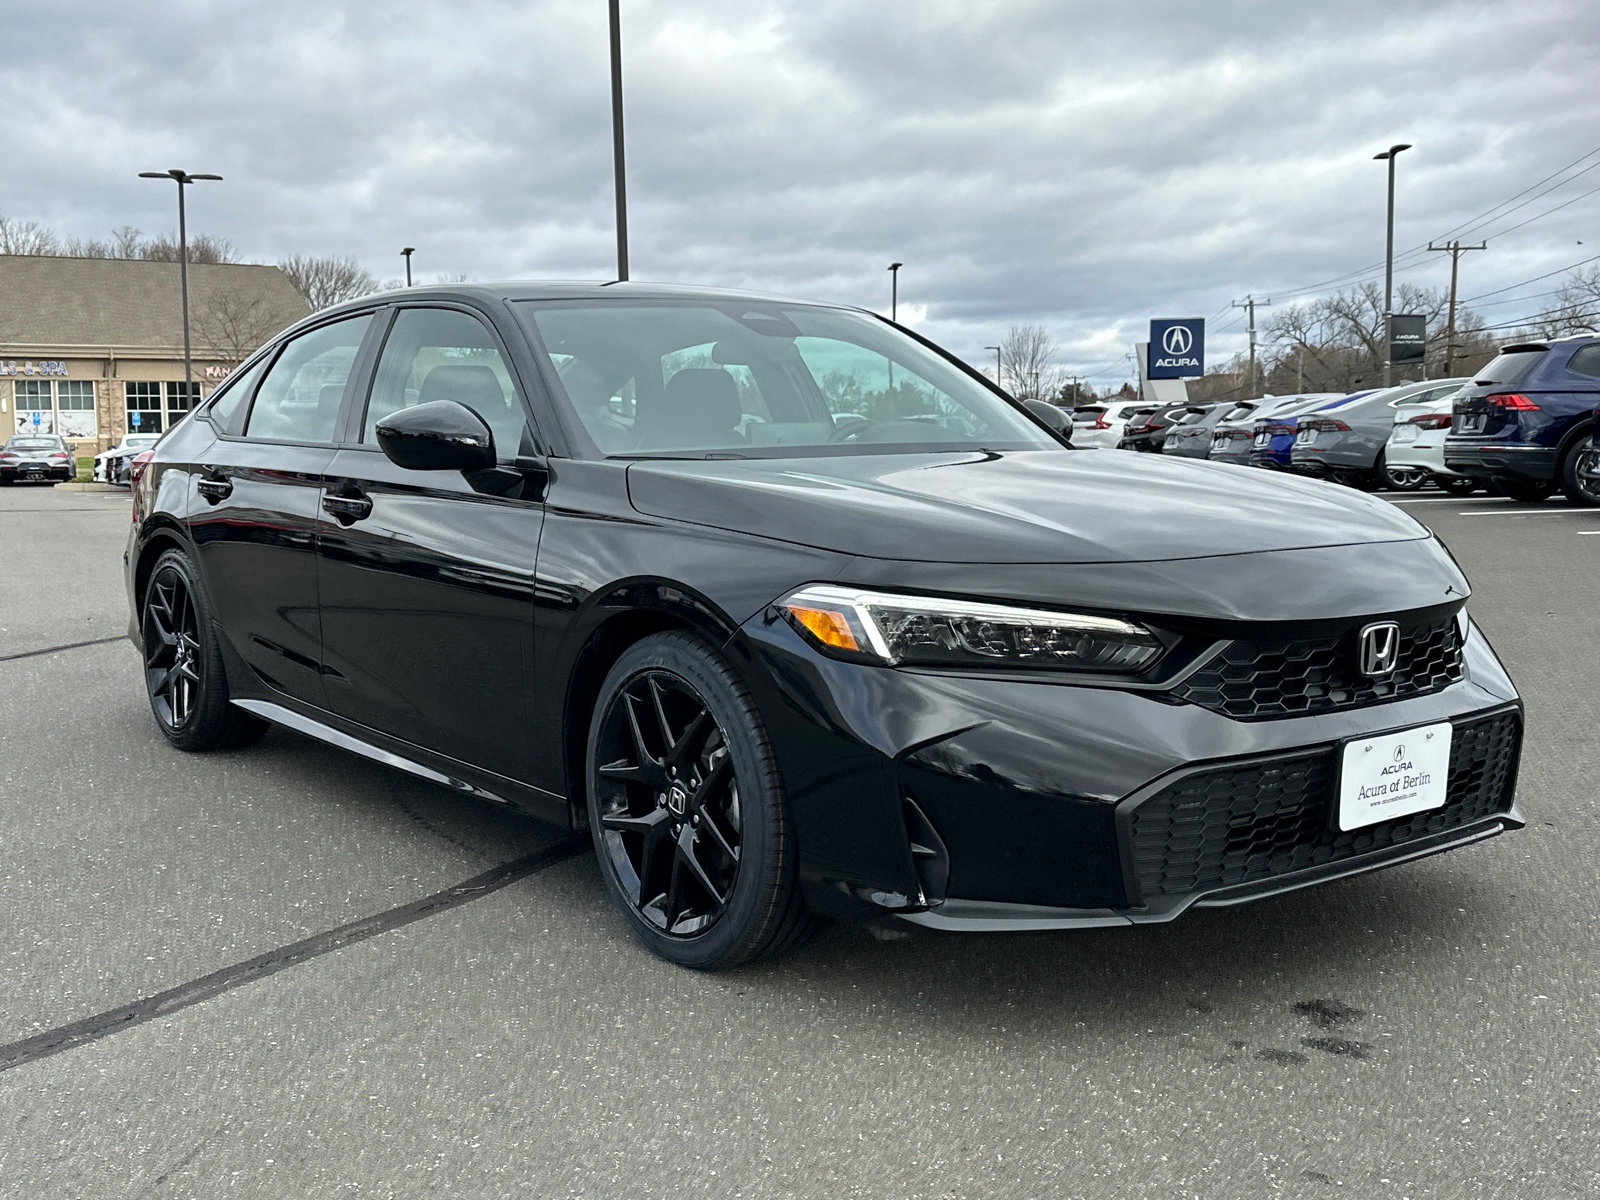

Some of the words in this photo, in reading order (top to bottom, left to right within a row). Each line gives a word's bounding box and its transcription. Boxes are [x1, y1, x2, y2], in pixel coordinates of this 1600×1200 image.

[24, 361, 35, 376] &
[39, 361, 68, 376] SPA
[1155, 358, 1199, 367] ACURA
[206, 366, 234, 378] FAN
[1366, 626, 1396, 673] H
[1381, 761, 1413, 776] ACURA
[1358, 784, 1388, 801] Acura
[1389, 779, 1401, 793] of
[1402, 771, 1431, 790] Berlin
